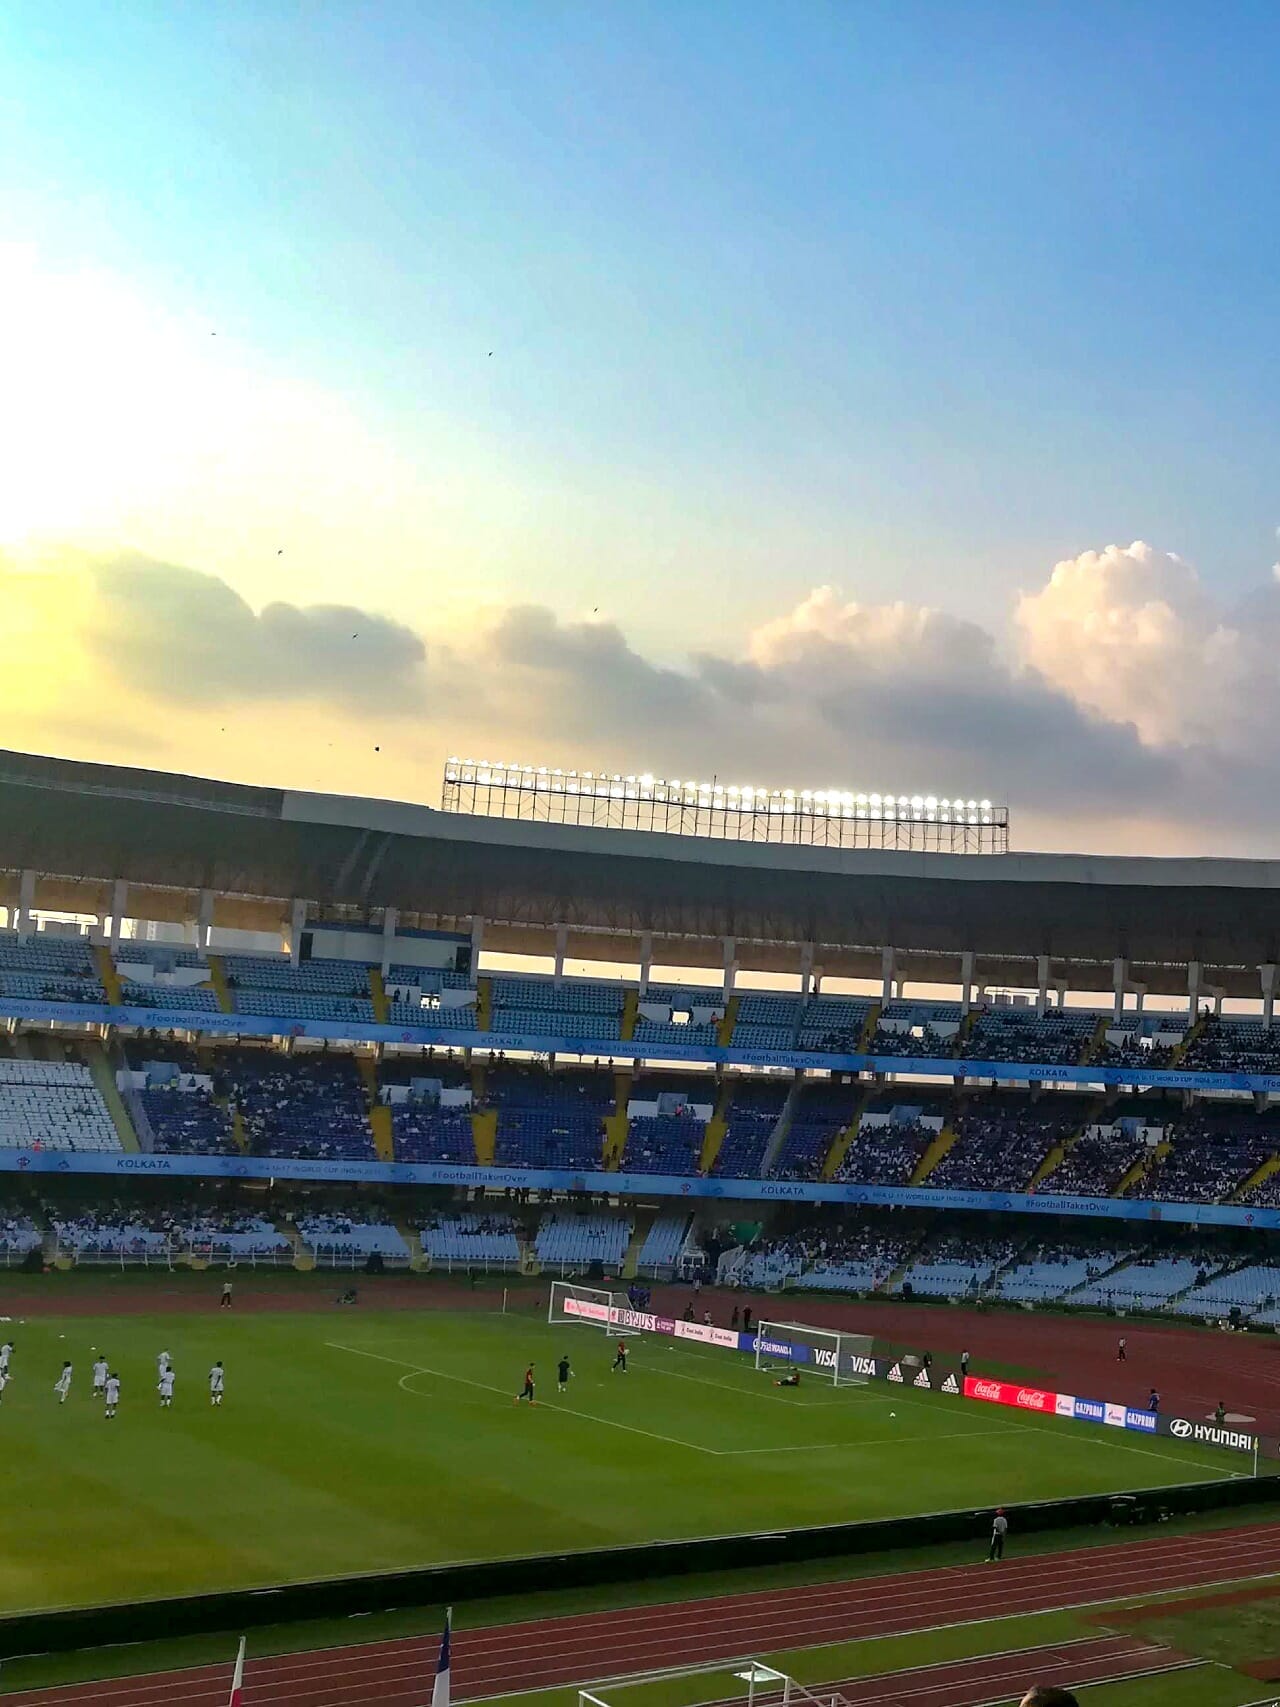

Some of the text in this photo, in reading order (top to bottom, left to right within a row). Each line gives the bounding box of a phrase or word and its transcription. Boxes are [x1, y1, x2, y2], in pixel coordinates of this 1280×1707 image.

[1029, 1069, 1068, 1077] KOLKATA
[117, 1159, 171, 1169] KOLKATA
[761, 1186, 805, 1195] KOLKATA
[814, 1349, 837, 1367] VISA
[851, 1355, 876, 1375] VISA
[887, 1374, 904, 1383] adidas
[913, 1379, 931, 1388] adidas
[941, 1385, 959, 1394] adidas
[1076, 1402, 1103, 1418] GAZPROM
[1127, 1413, 1155, 1428] GAZPROM
[1195, 1424, 1251, 1450] HYUNDAI
